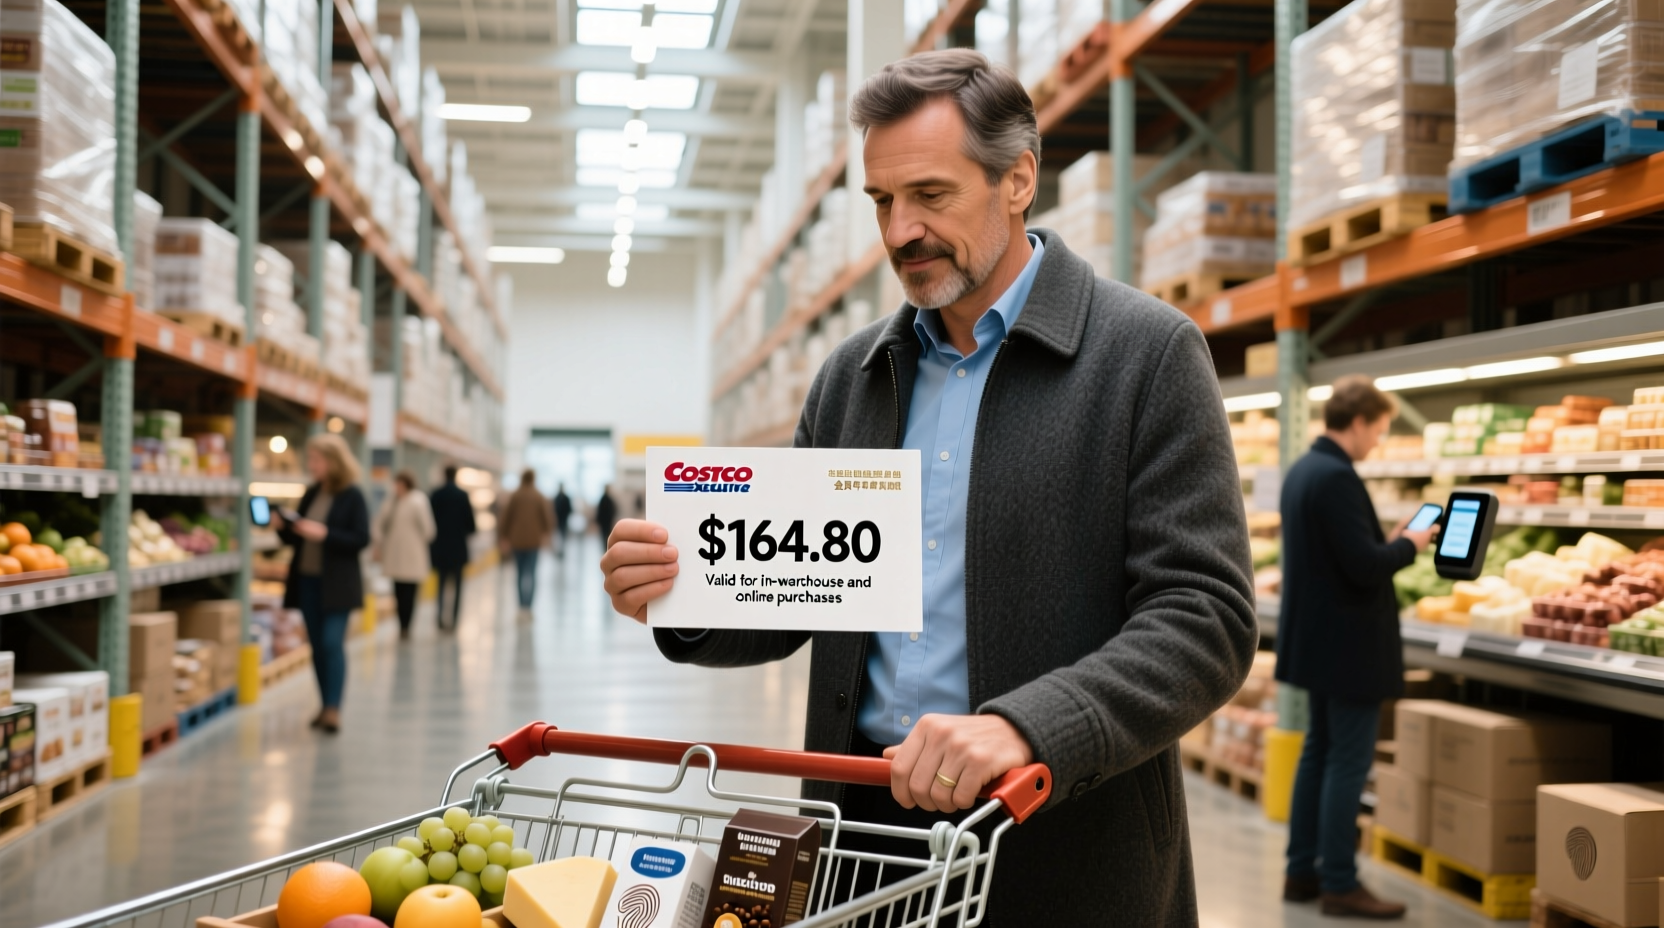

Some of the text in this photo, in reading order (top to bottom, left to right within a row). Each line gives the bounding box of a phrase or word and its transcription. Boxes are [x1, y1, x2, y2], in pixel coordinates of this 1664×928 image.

[664, 461, 753, 482] COSTCO
[698, 513, 882, 566] $164.80
[705, 573, 736, 587] Valid
[740, 574, 758, 587] for
[847, 575, 872, 588] and
[777, 590, 843, 607] purchases
